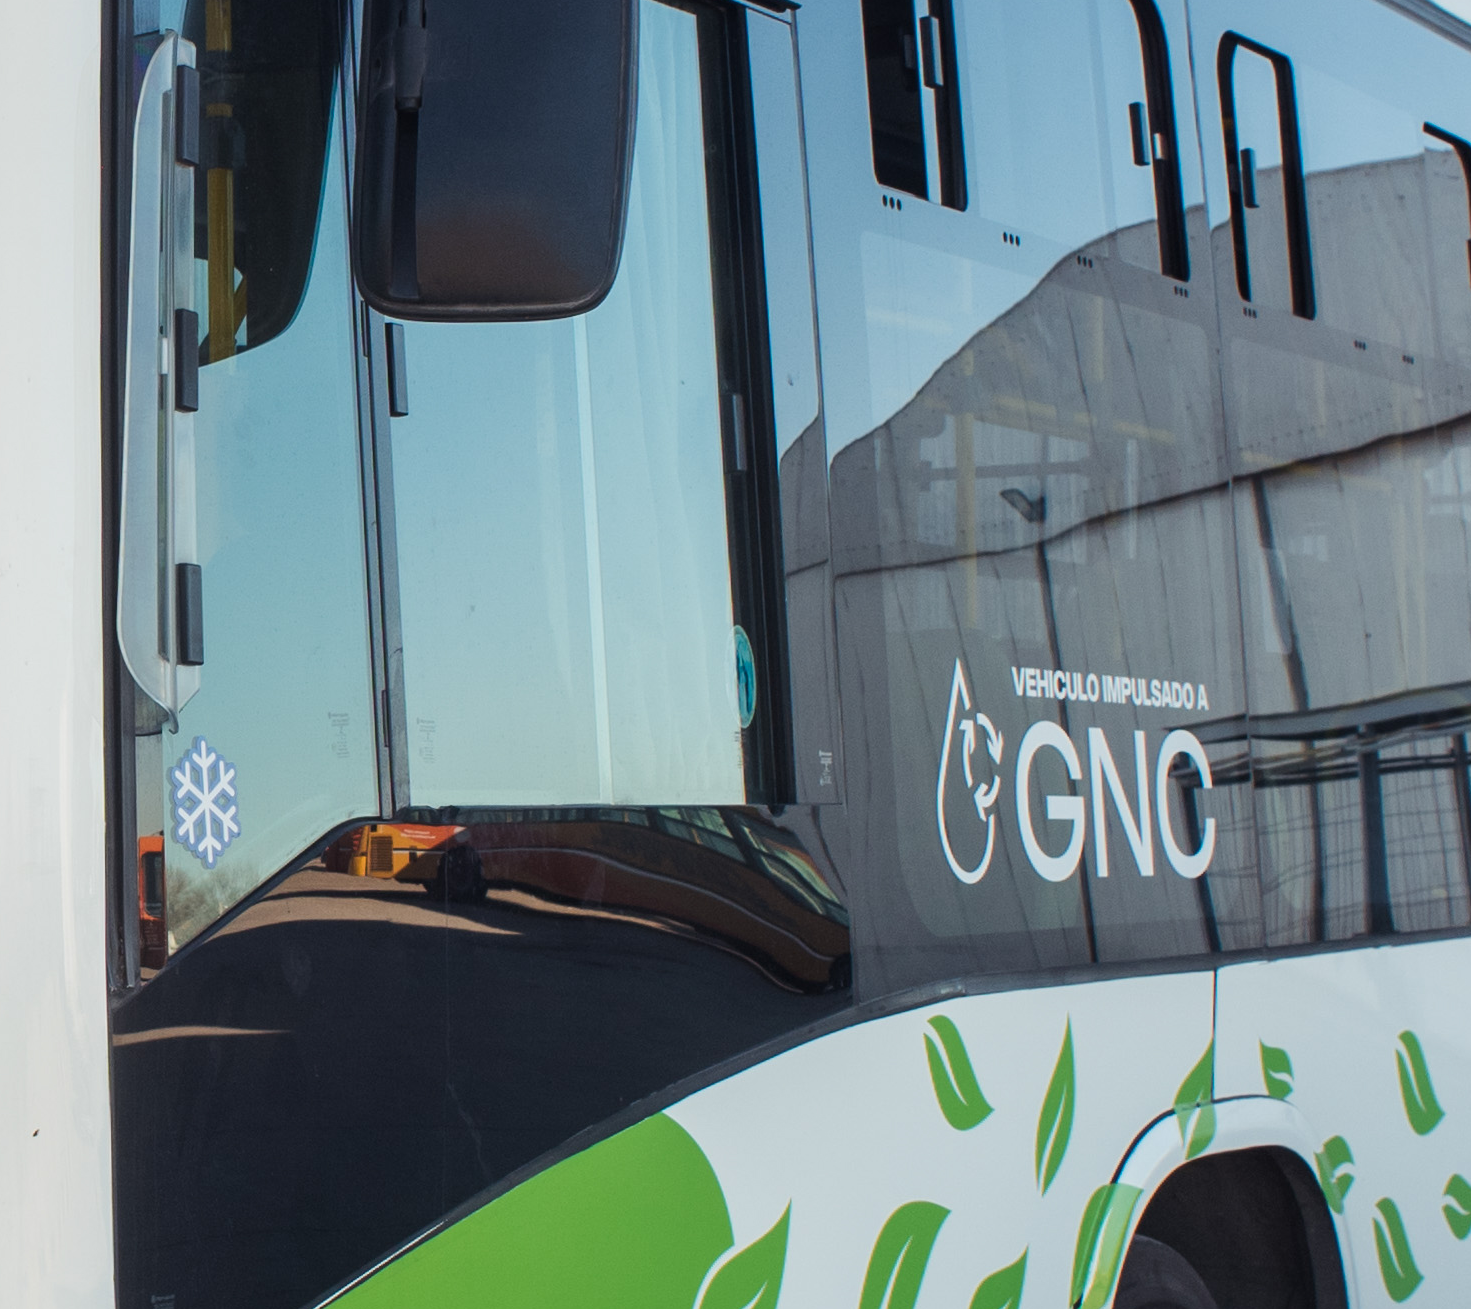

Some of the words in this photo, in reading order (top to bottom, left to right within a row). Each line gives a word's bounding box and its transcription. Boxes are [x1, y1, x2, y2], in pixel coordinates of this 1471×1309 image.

[1011, 665, 1099, 702] VEHICULO
[1102, 674, 1194, 710] IMPULSADO
[1197, 683, 1209, 711] A
[1015, 720, 1217, 883] GNC
